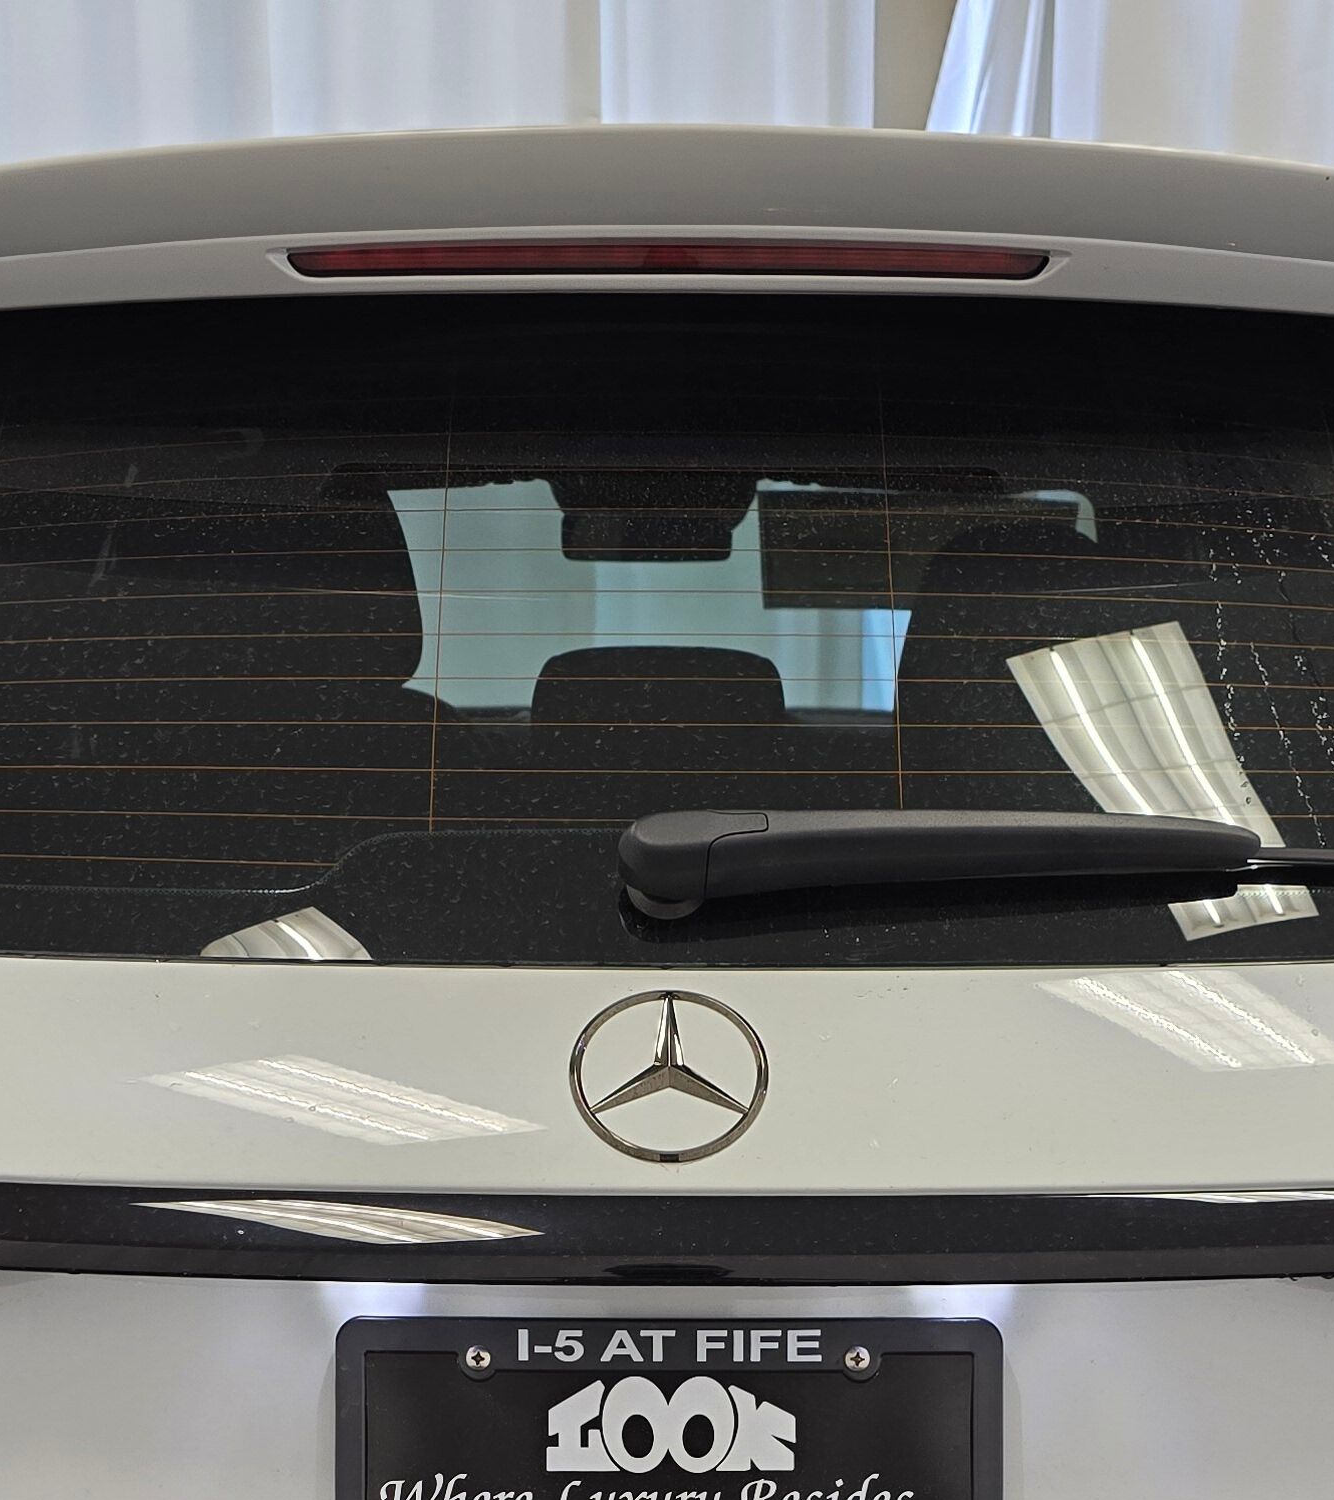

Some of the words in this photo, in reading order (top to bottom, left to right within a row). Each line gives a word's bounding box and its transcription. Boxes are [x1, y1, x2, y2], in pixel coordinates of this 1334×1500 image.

[517, 1328, 585, 1362] I-5
[600, 1328, 676, 1362] AT
[696, 1328, 823, 1362] FIFE
[546, 1375, 797, 1474] LOOK
